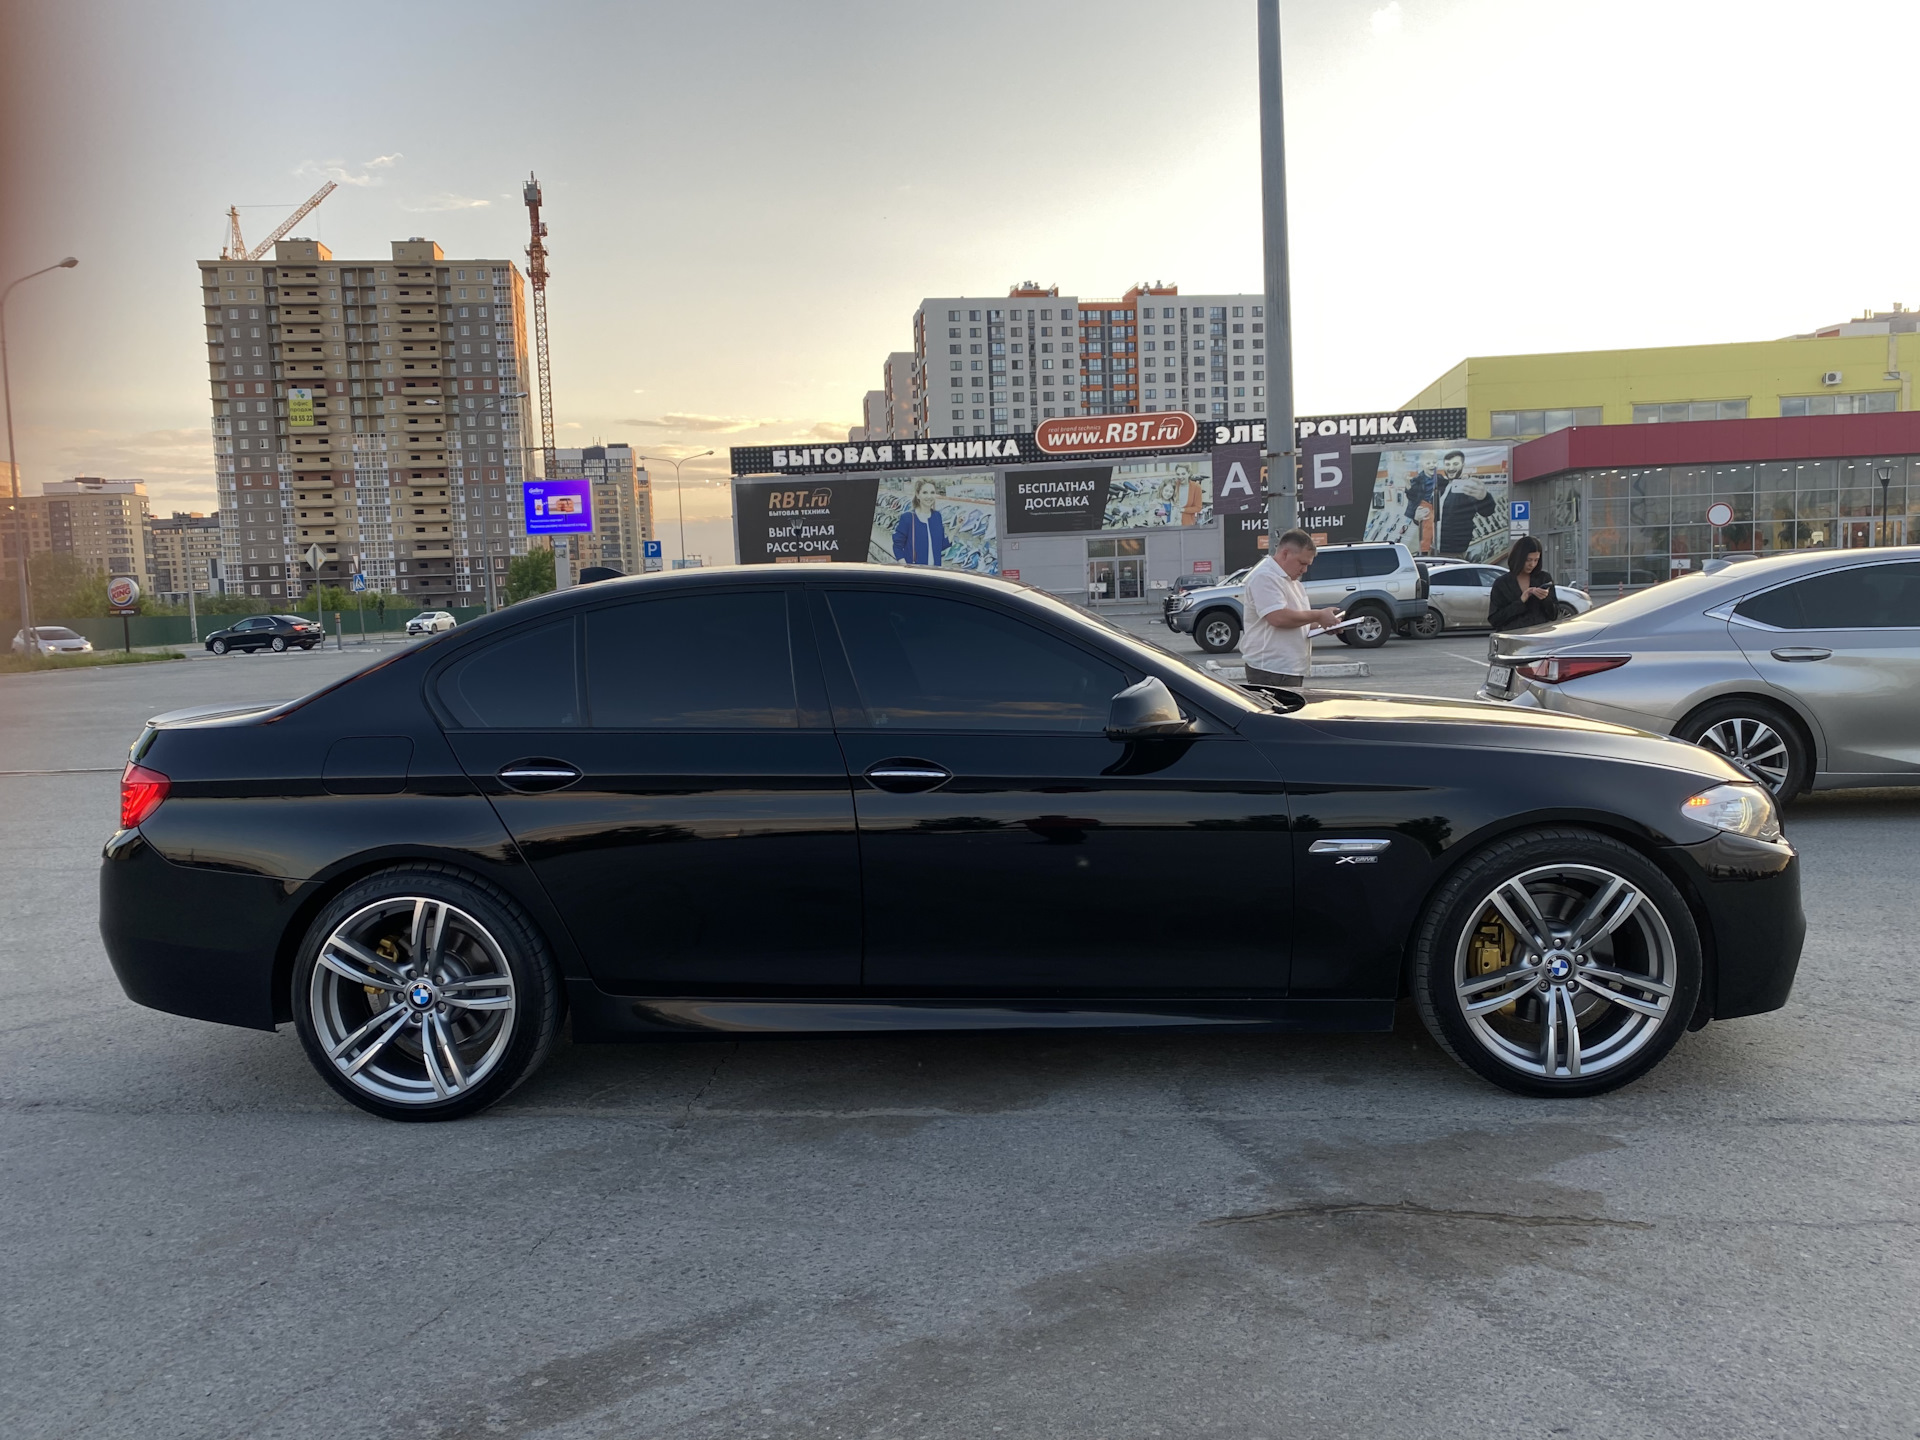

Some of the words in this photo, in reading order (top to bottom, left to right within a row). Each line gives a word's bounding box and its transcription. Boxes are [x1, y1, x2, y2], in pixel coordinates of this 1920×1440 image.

[1048, 421, 1179, 446] www.RBT.ru
[1215, 416, 1418, 444] ЭЛЕРОНИКА
[773, 446, 893, 467] БЫТОВАЯ
[902, 439, 1020, 461] ТЕХНИКА
[1220, 462, 1254, 497] А
[1313, 452, 1343, 489] Б
[1018, 480, 1095, 494] БЕСПЛАТНАЯ
[769, 491, 828, 509] RBT.ru
[1024, 495, 1089, 510] ДОСТАВКА
[1305, 515, 1343, 529] ЦЕНЫ
[112, 588, 131, 599] KING
